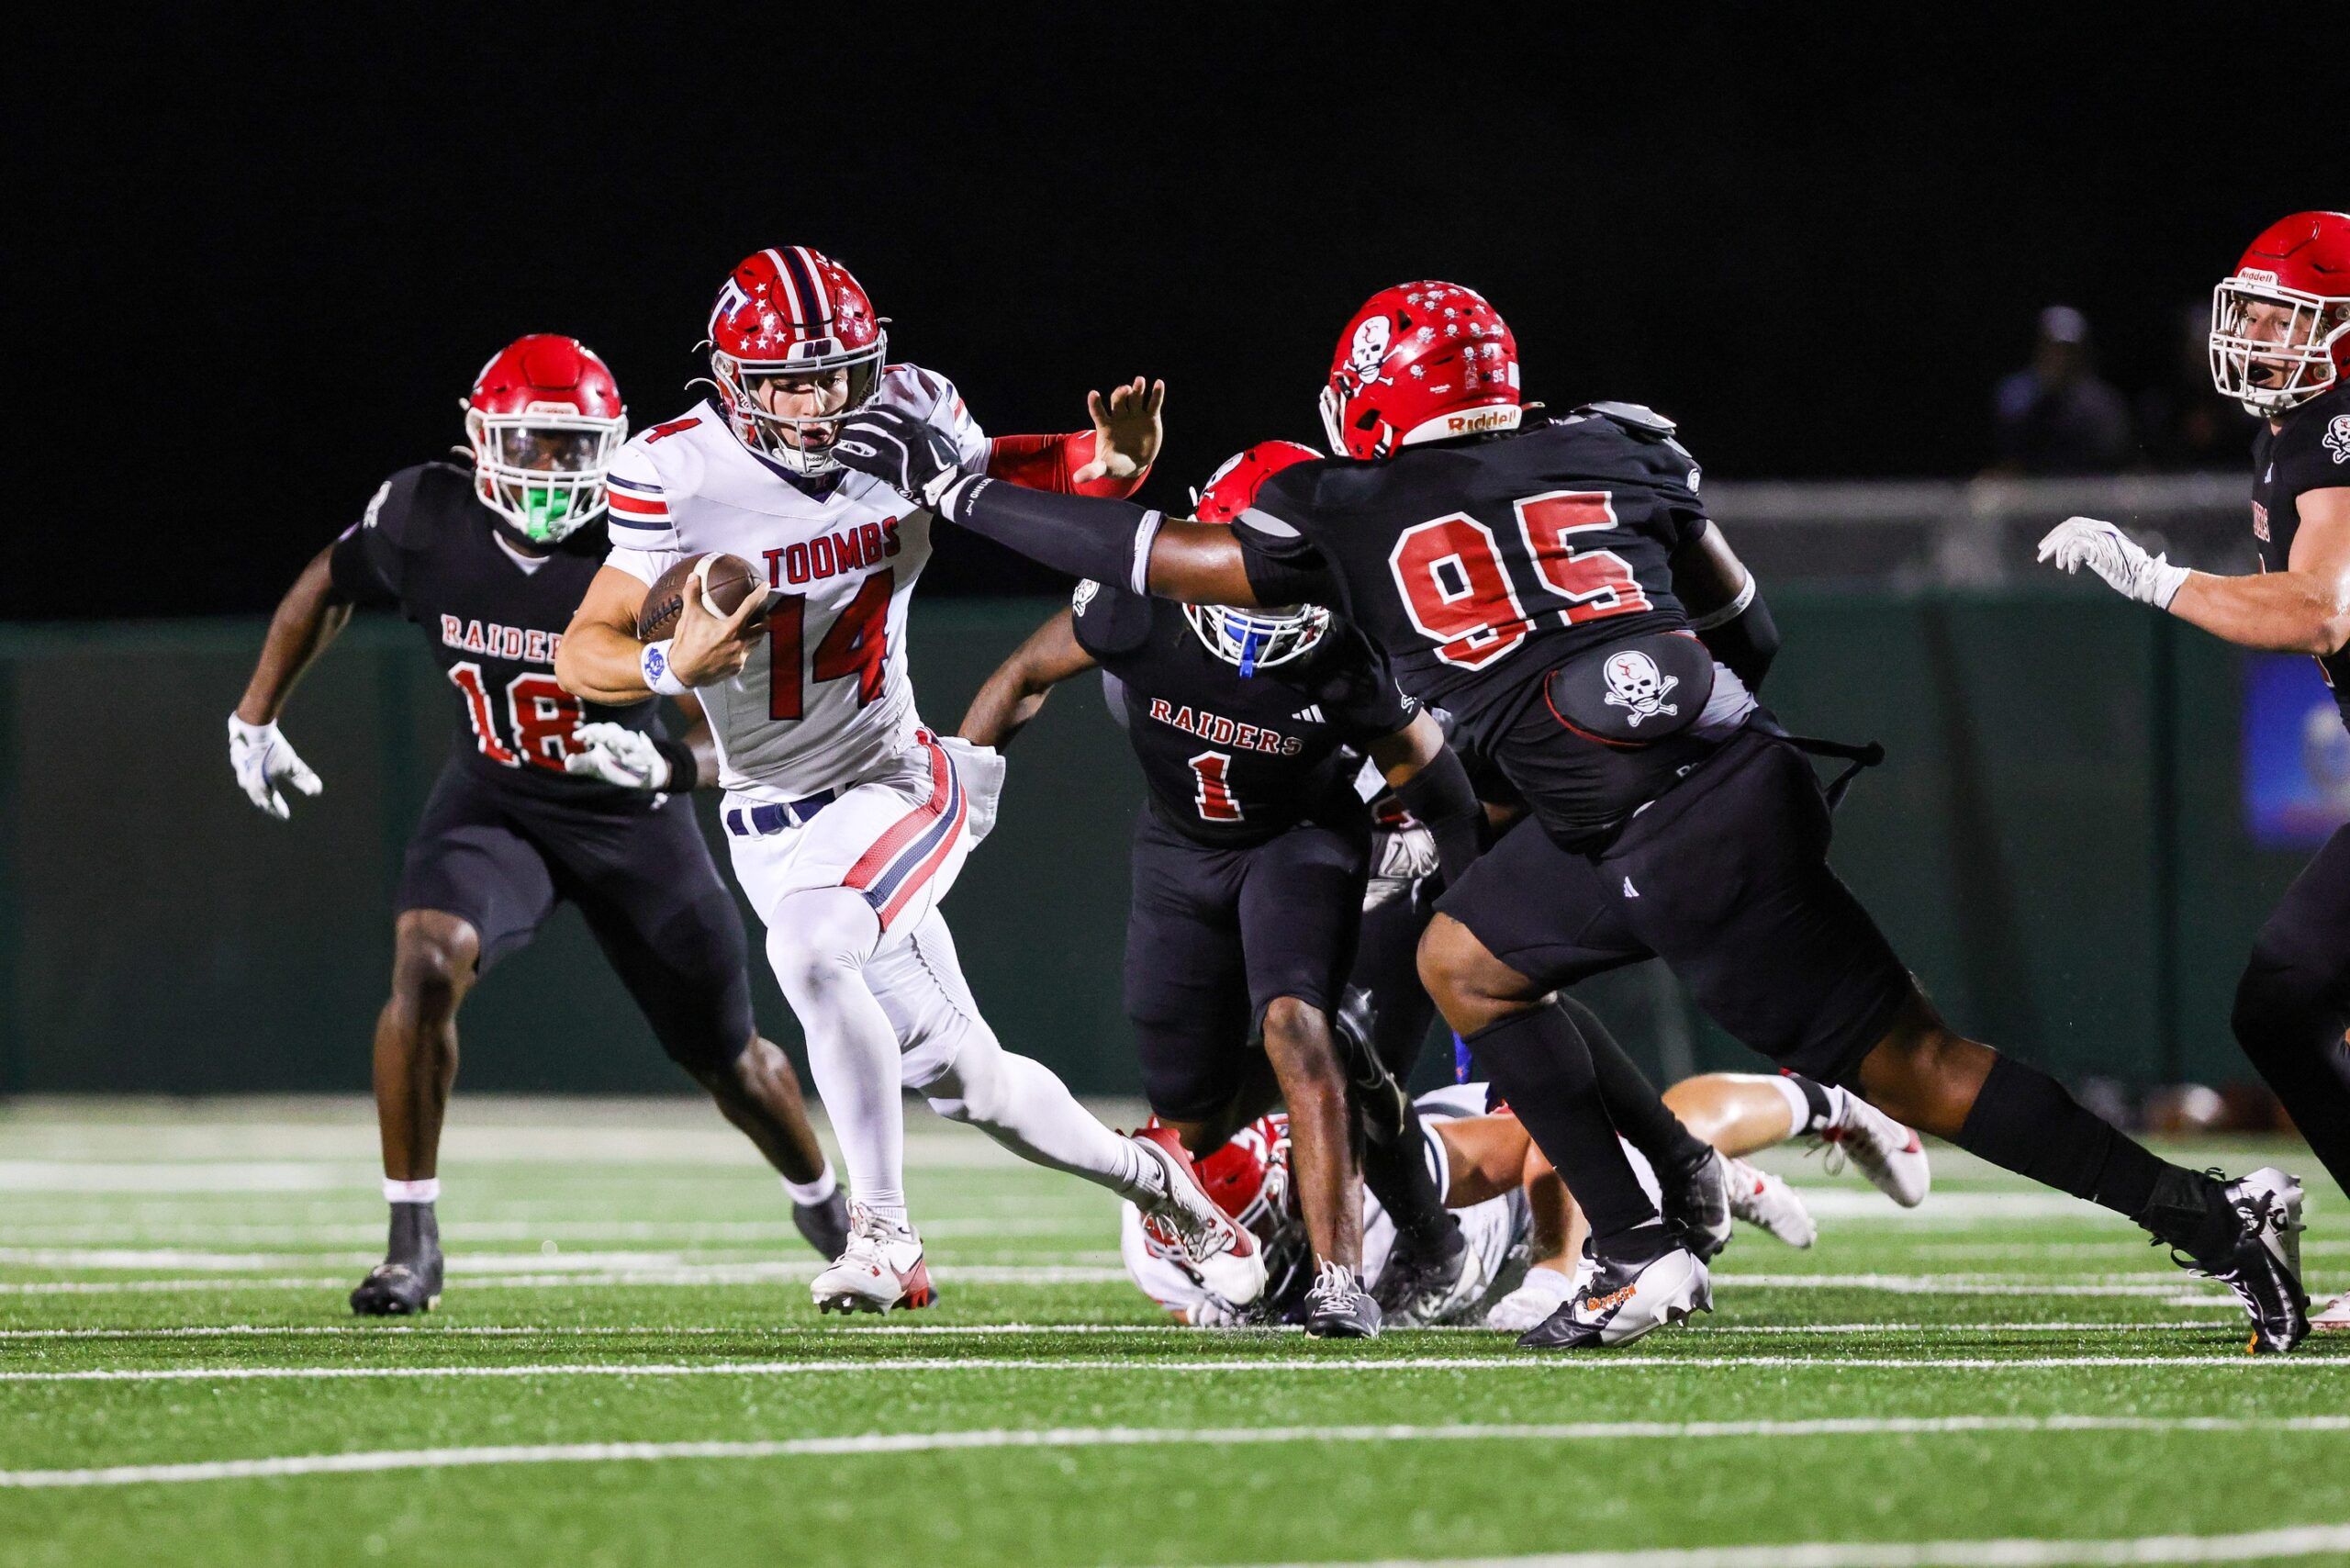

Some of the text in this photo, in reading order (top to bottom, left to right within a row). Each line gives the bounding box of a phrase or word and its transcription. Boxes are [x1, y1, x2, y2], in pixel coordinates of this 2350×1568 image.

[1492, 368, 1505, 383] 95
[1448, 409, 1516, 433] Riddell
[763, 515, 901, 589] TOOMBS
[1388, 489, 1654, 672] 95
[767, 566, 896, 721] 14
[448, 661, 587, 773] 18
[1149, 697, 1305, 756] RAIDERS
[1188, 750, 1245, 822] 1
